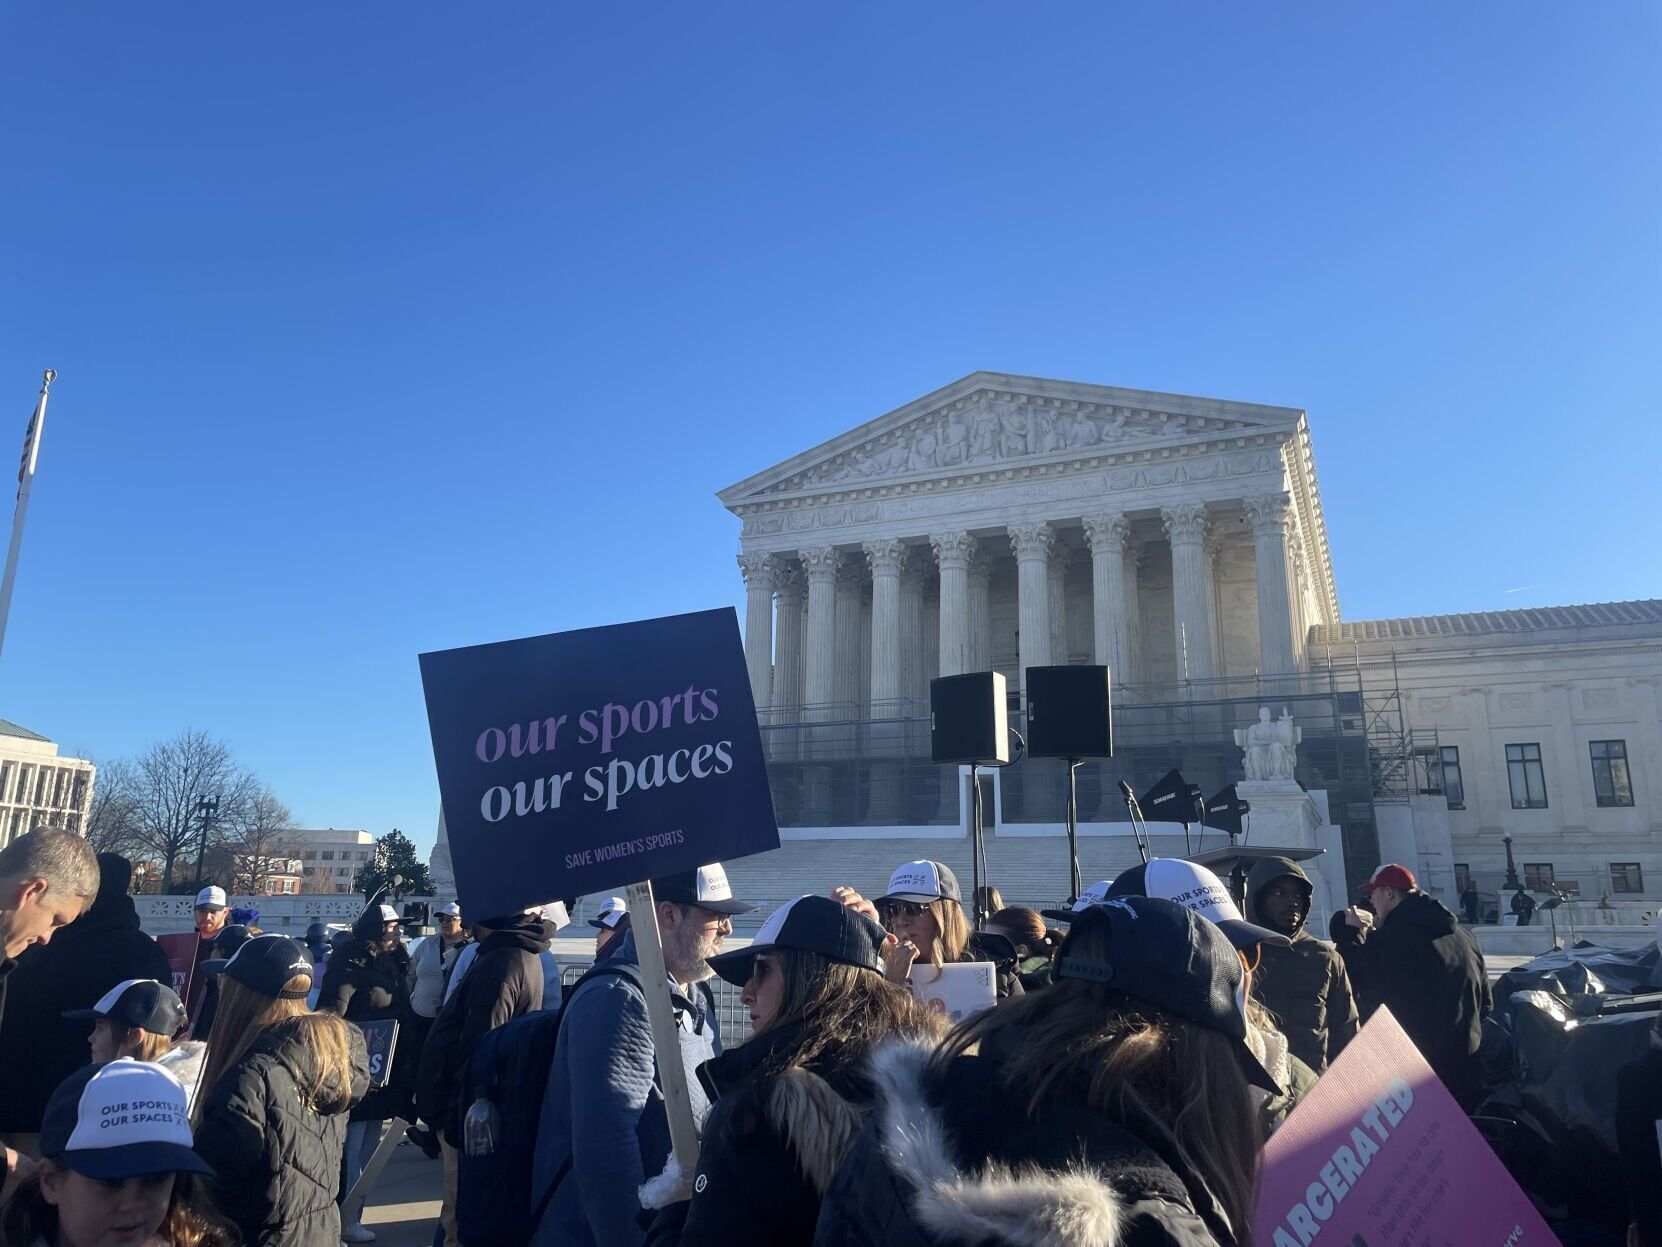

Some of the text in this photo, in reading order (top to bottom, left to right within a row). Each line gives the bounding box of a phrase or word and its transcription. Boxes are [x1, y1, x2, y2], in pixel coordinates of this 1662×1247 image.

[475, 684, 719, 763] our sports
[480, 740, 733, 822] our spaces
[565, 829, 684, 868] SAVE WOMEN'S SPORTS
[1170, 892, 1192, 904] OUR
[100, 1116, 128, 1128] OUR
[132, 1113, 173, 1123] SPACES
[101, 1101, 172, 1115] OUR SPORTS
